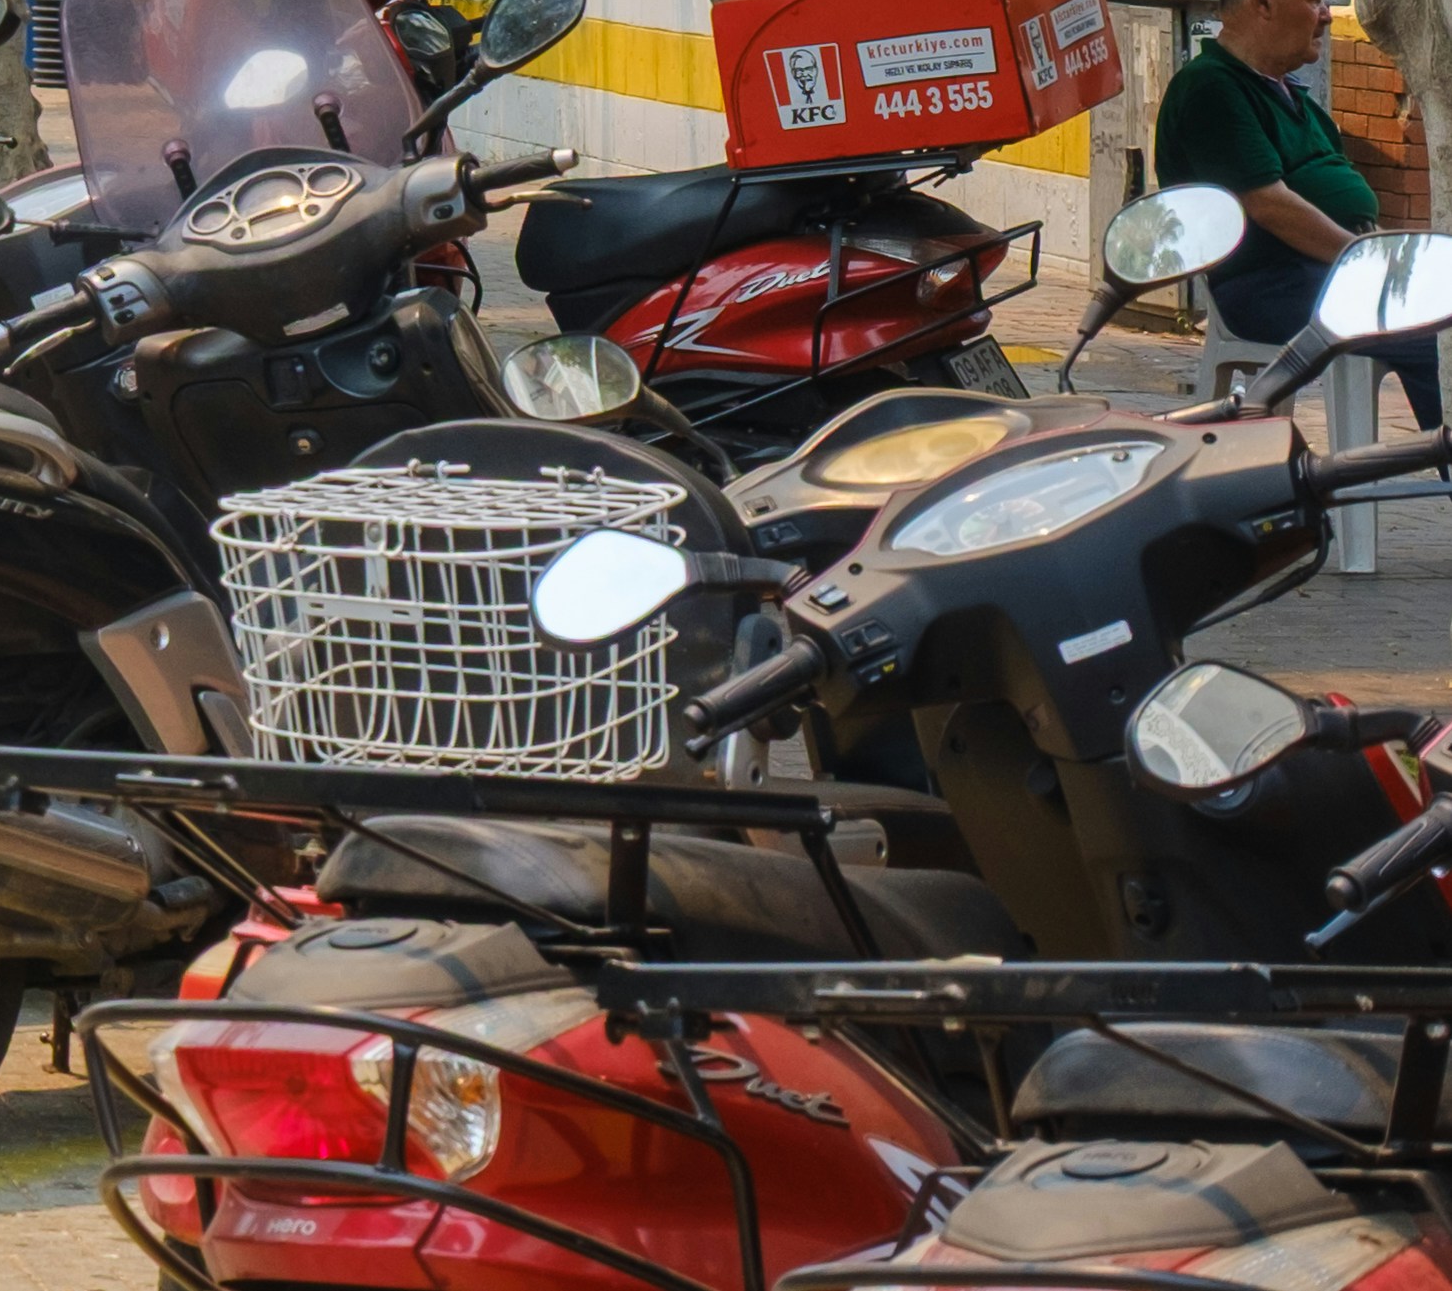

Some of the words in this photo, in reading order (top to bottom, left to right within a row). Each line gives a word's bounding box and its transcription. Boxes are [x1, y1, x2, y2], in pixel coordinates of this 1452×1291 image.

[867, 36, 983, 58] kfcturkiye.com
[1037, 66, 1054, 85] KFC
[873, 90, 922, 119] 444
[926, 87, 943, 114] 3
[946, 81, 993, 112] 555
[791, 104, 836, 124] KFC
[954, 359, 980, 387] 09
[973, 345, 1007, 378] AFA
